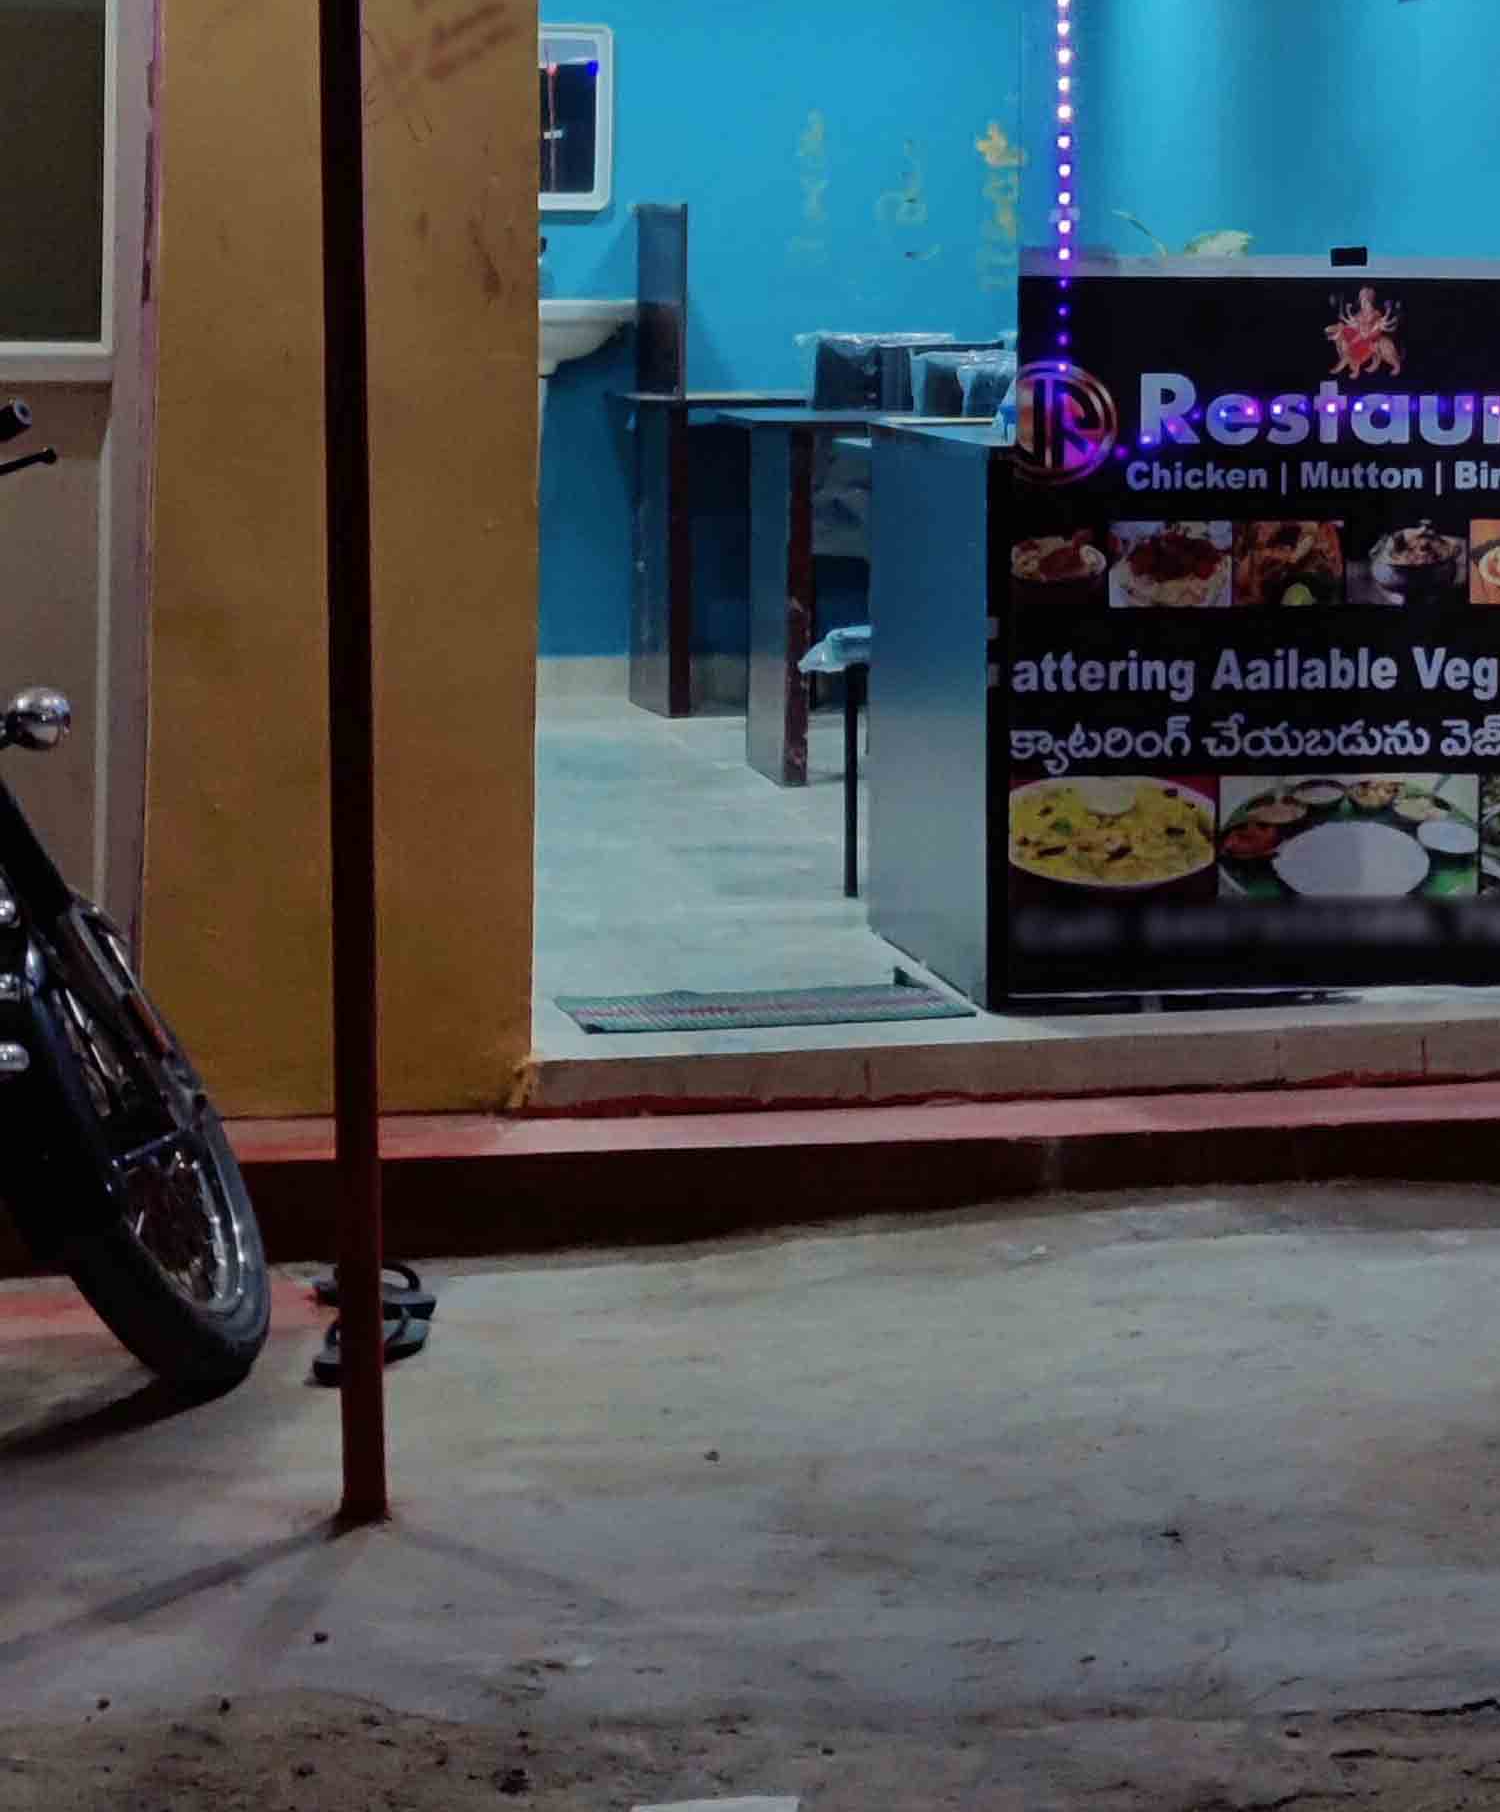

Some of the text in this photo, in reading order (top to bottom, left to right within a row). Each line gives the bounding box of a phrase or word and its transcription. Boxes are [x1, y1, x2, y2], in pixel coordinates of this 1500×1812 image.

[1125, 460, 1268, 491] Chicken
[1301, 461, 1424, 490] Mutton
[1211, 647, 1399, 691] Aailable
[1412, 646, 1499, 701] Veg
